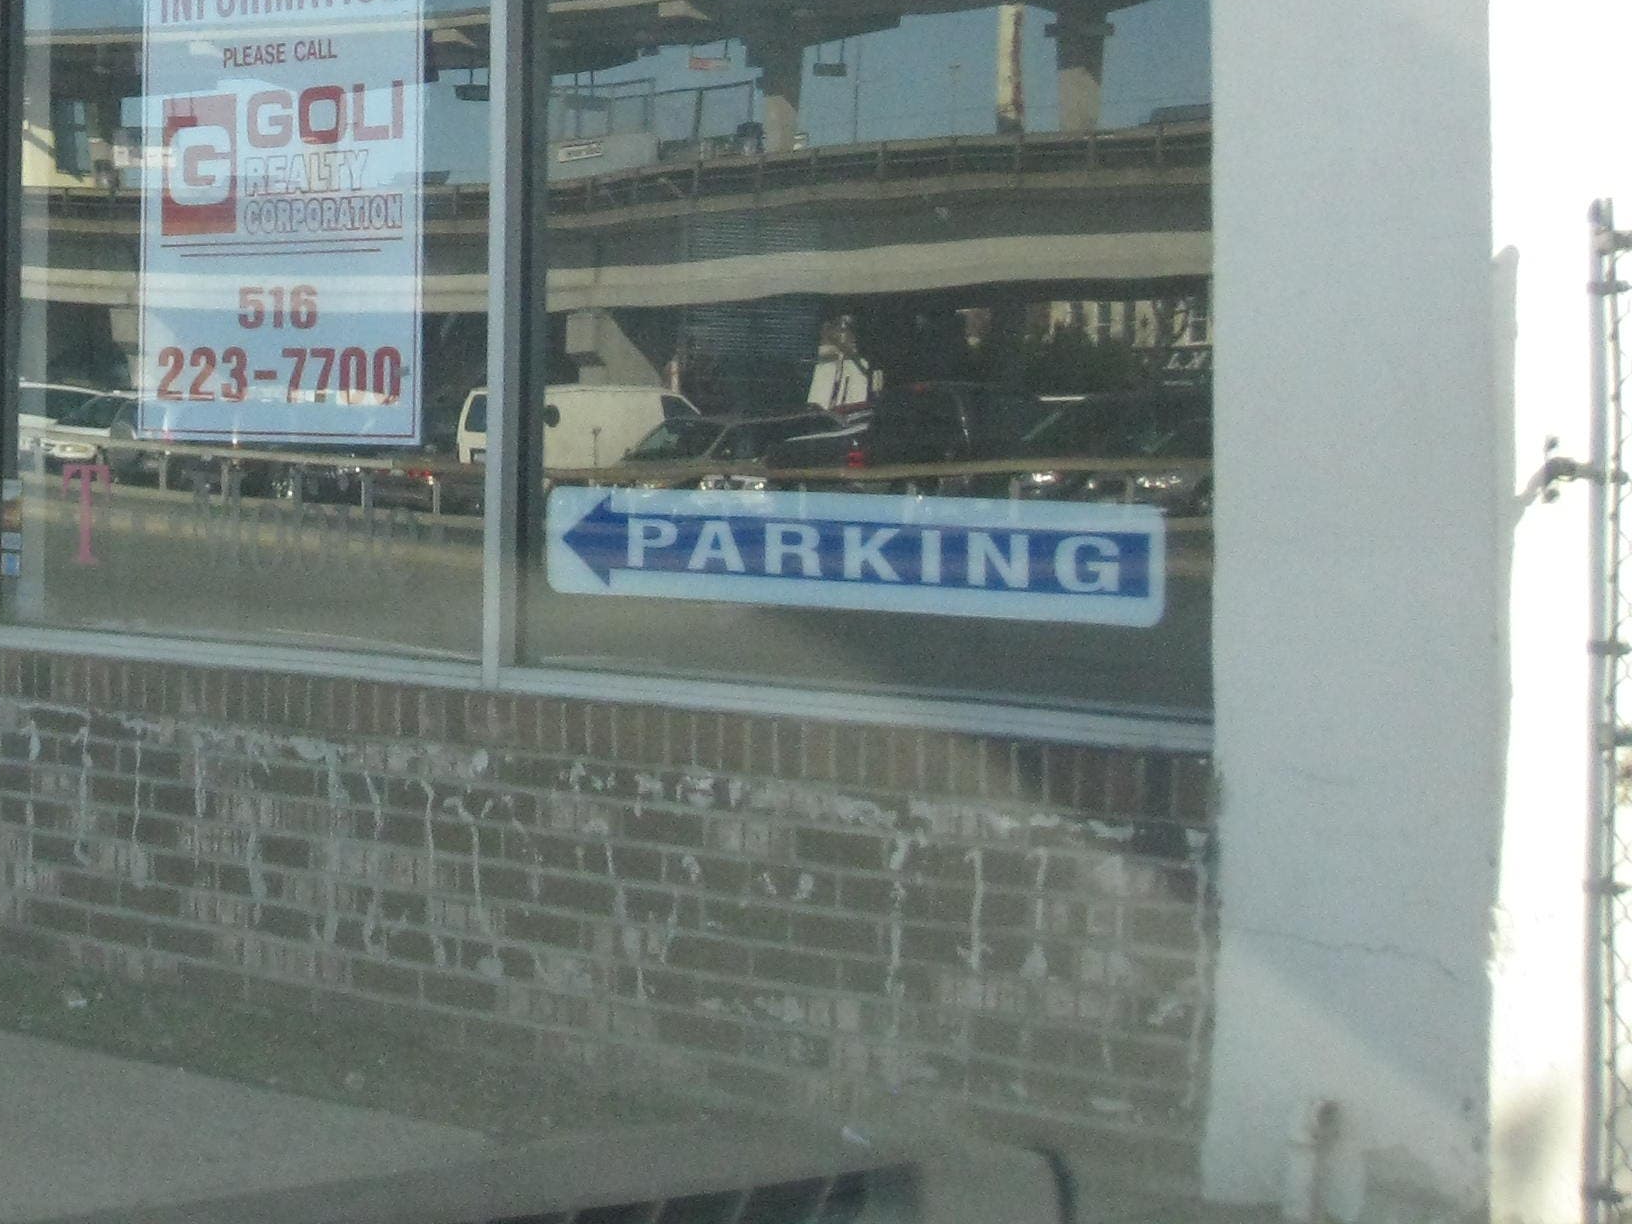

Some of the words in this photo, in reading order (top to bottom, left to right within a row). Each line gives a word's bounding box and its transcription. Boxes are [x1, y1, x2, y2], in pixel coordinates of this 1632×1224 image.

[222, 43, 286, 68] PLEASE
[294, 39, 338, 61] CALL
[246, 79, 404, 149] GOLI
[243, 149, 368, 196] REALTY
[243, 194, 404, 235] CORPORATION
[237, 284, 318, 330] 516
[156, 346, 402, 405] 223-7700
[625, 516, 1120, 593] PARKING
